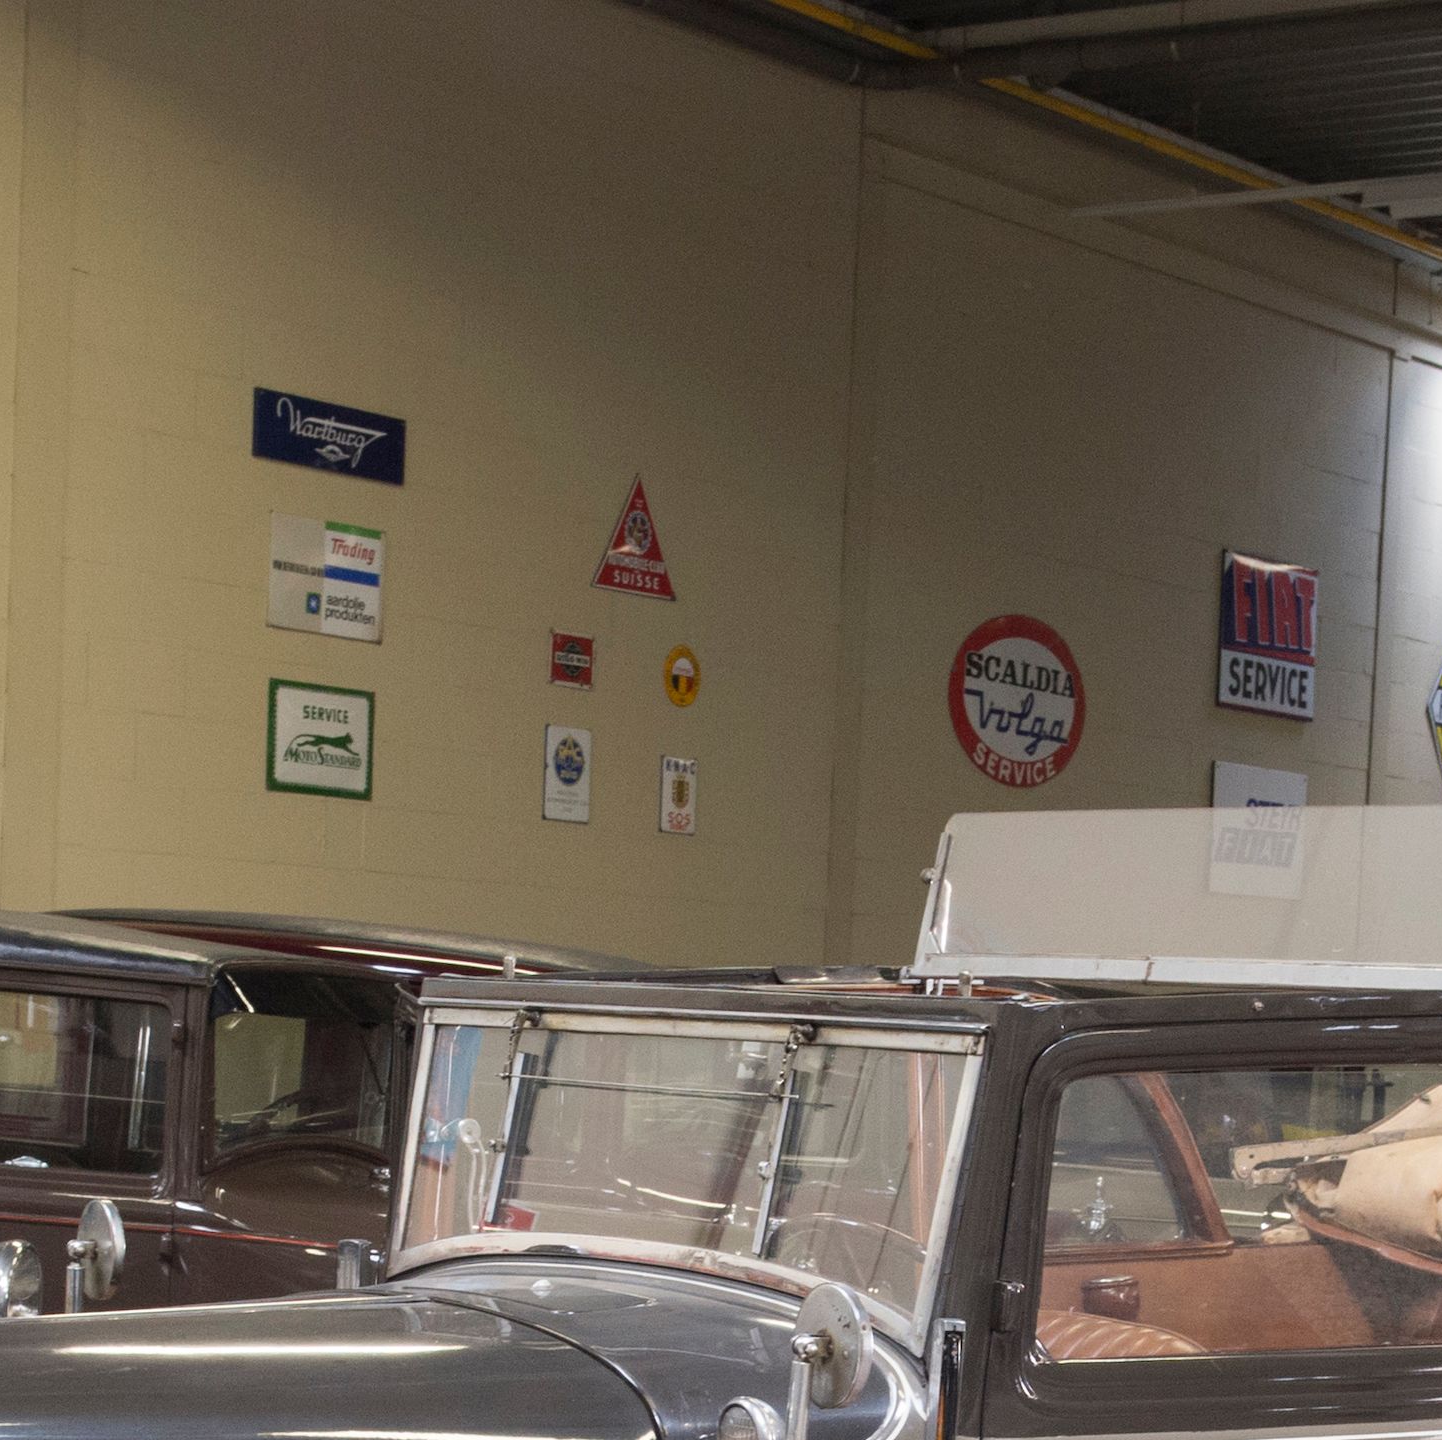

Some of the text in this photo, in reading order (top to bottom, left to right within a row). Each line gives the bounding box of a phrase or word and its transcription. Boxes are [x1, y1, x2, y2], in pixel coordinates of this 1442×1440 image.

[276, 397, 387, 468] Wartburg
[330, 537, 376, 566] Trading
[613, 569, 660, 590] SUISSE
[324, 607, 376, 626] produkten
[326, 594, 366, 611] aardolie
[1232, 560, 1316, 650] FIAT
[965, 651, 1076, 699] SCALDIA
[1228, 656, 1308, 709] SERVICE
[302, 705, 350, 724] SERVICE
[972, 742, 1057, 785] SERVICE
